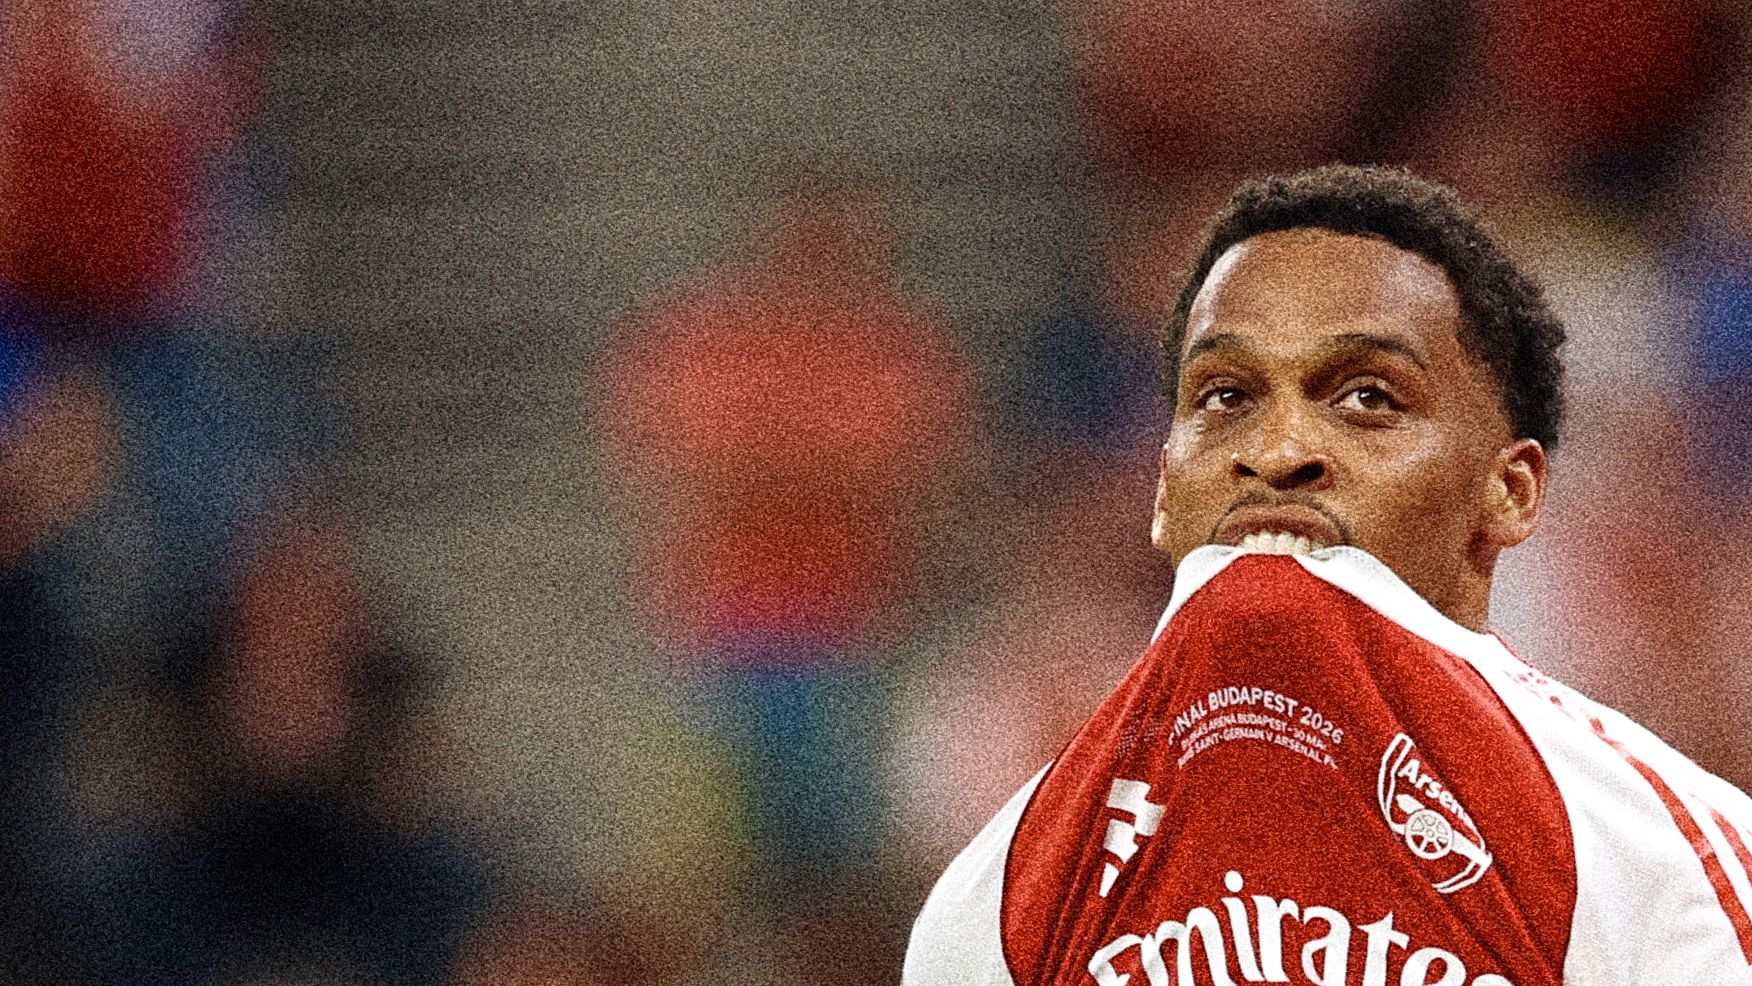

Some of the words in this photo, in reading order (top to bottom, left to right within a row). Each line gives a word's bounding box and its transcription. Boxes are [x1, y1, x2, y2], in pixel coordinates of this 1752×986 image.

[1208, 686, 1298, 717] BUDAPEST
[1300, 706, 1344, 744] 2026
[1274, 735, 1322, 763] ARSENAL
[1398, 759, 1477, 832] Arsen
